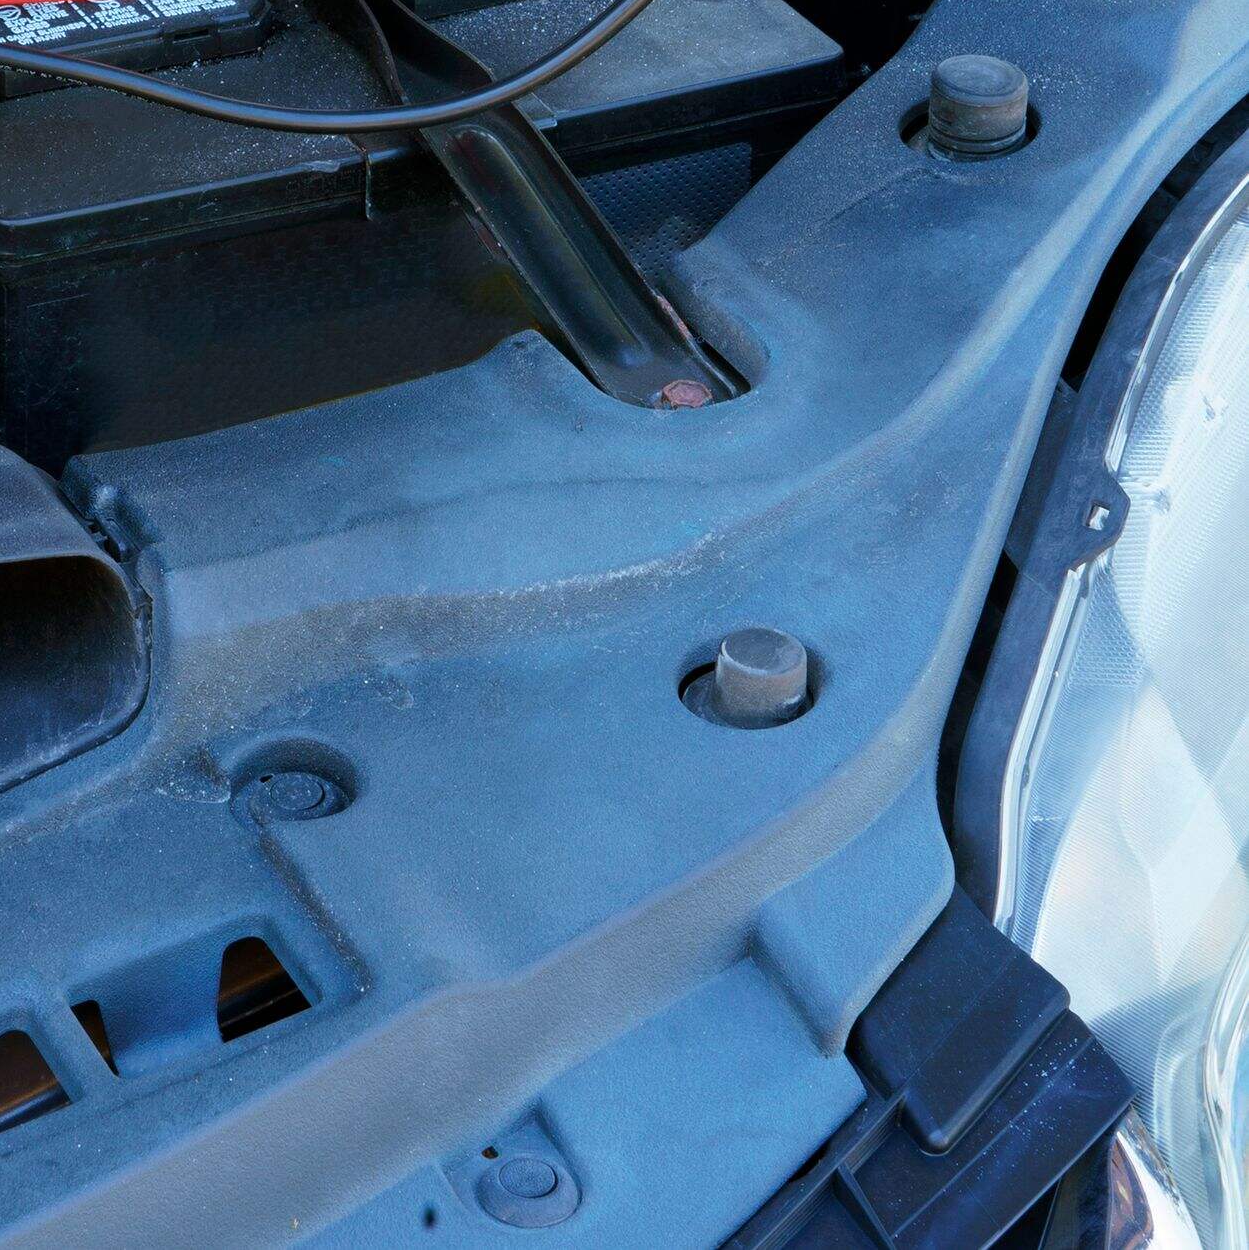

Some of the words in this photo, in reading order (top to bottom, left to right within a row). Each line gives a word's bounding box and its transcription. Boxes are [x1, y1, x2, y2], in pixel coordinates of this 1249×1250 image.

[94, 5, 136, 18] SPARKS
[98, 0, 121, 10] NO
[162, 6, 201, 17] SEVERE
[202, 0, 236, 11] BURNS
[4, 10, 69, 28] EXPLOSIVE
[99, 10, 140, 23] FLAMES
[104, 15, 150, 28] SMOKING
[11, 21, 50, 34] GASES
[37, 21, 87, 36] BLINDNESS
[18, 37, 34, 45] OR
[34, 31, 67, 43] INJURY
